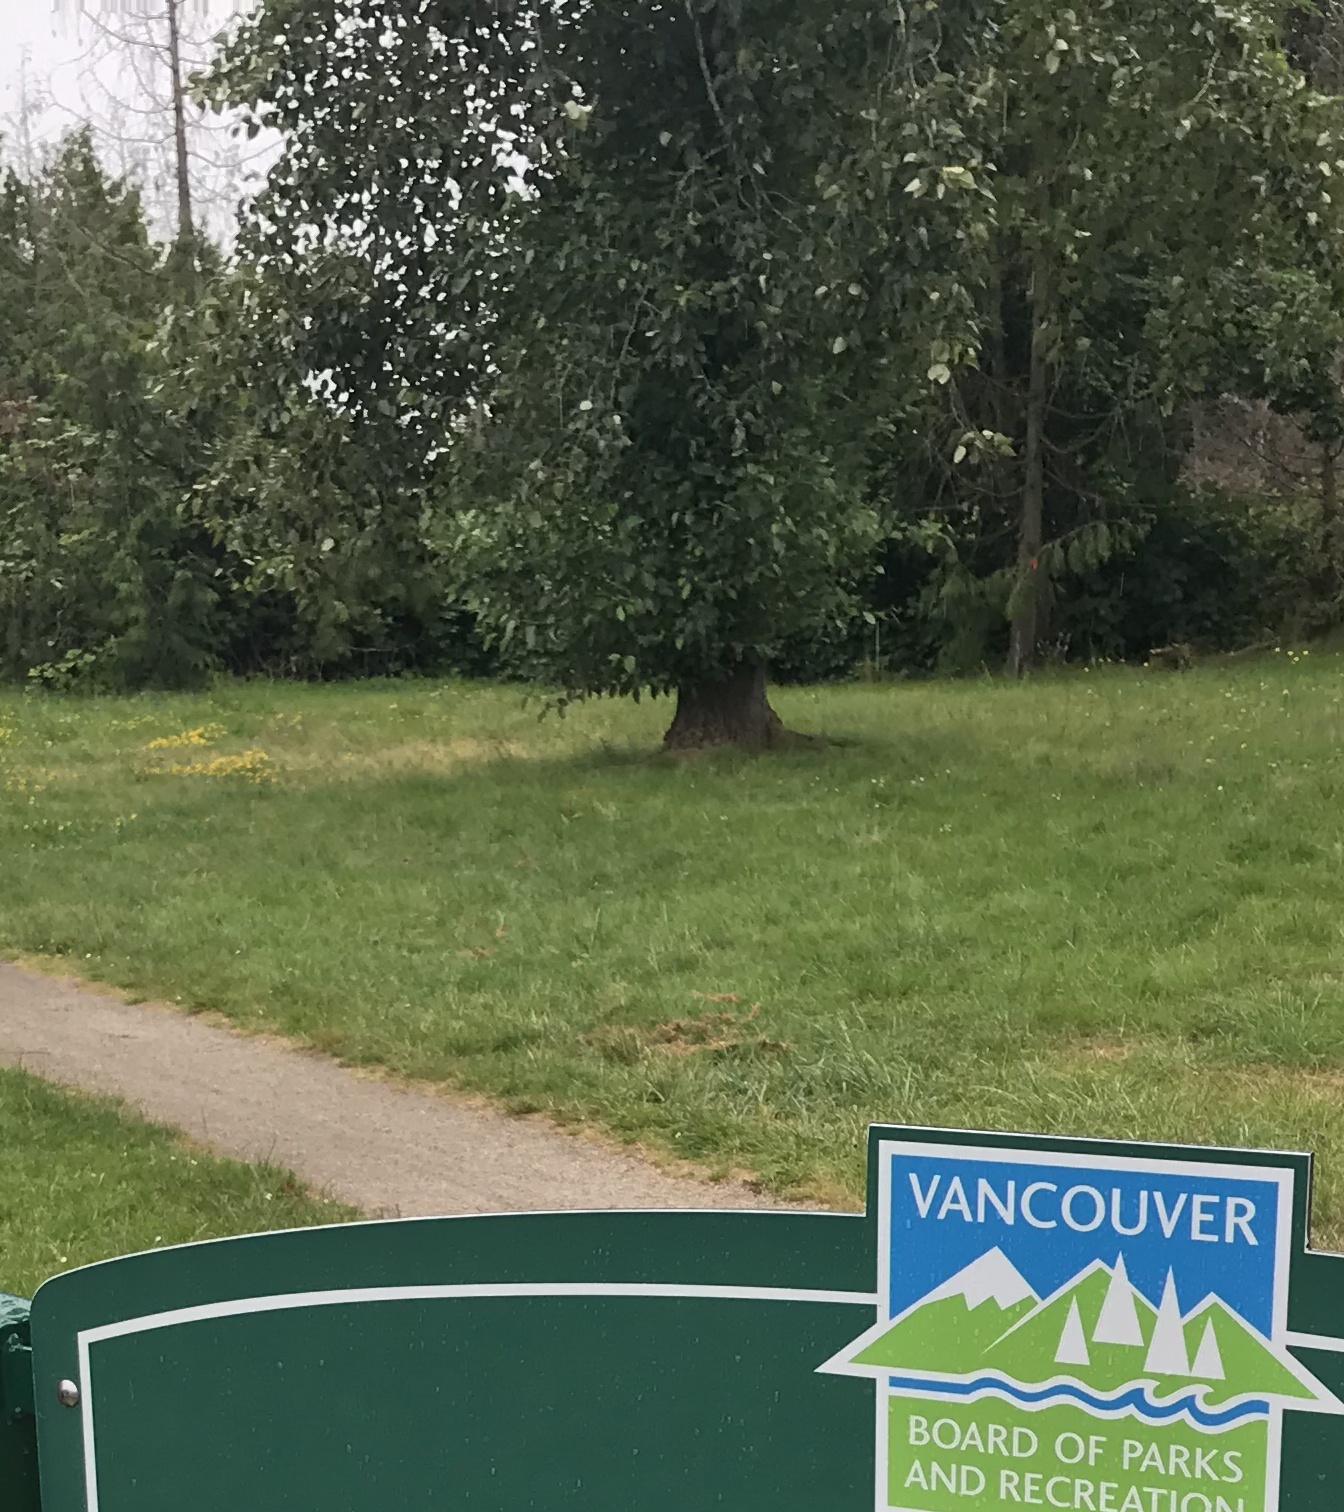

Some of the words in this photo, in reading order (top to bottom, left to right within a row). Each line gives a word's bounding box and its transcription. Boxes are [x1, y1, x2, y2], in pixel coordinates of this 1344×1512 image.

[908, 1172, 1259, 1246] VANCOUVER
[903, 1459, 986, 1497] AND
[908, 1415, 1038, 1459] BOARD
[1054, 1432, 1104, 1468] OF
[1122, 1438, 1243, 1484] PARKS
